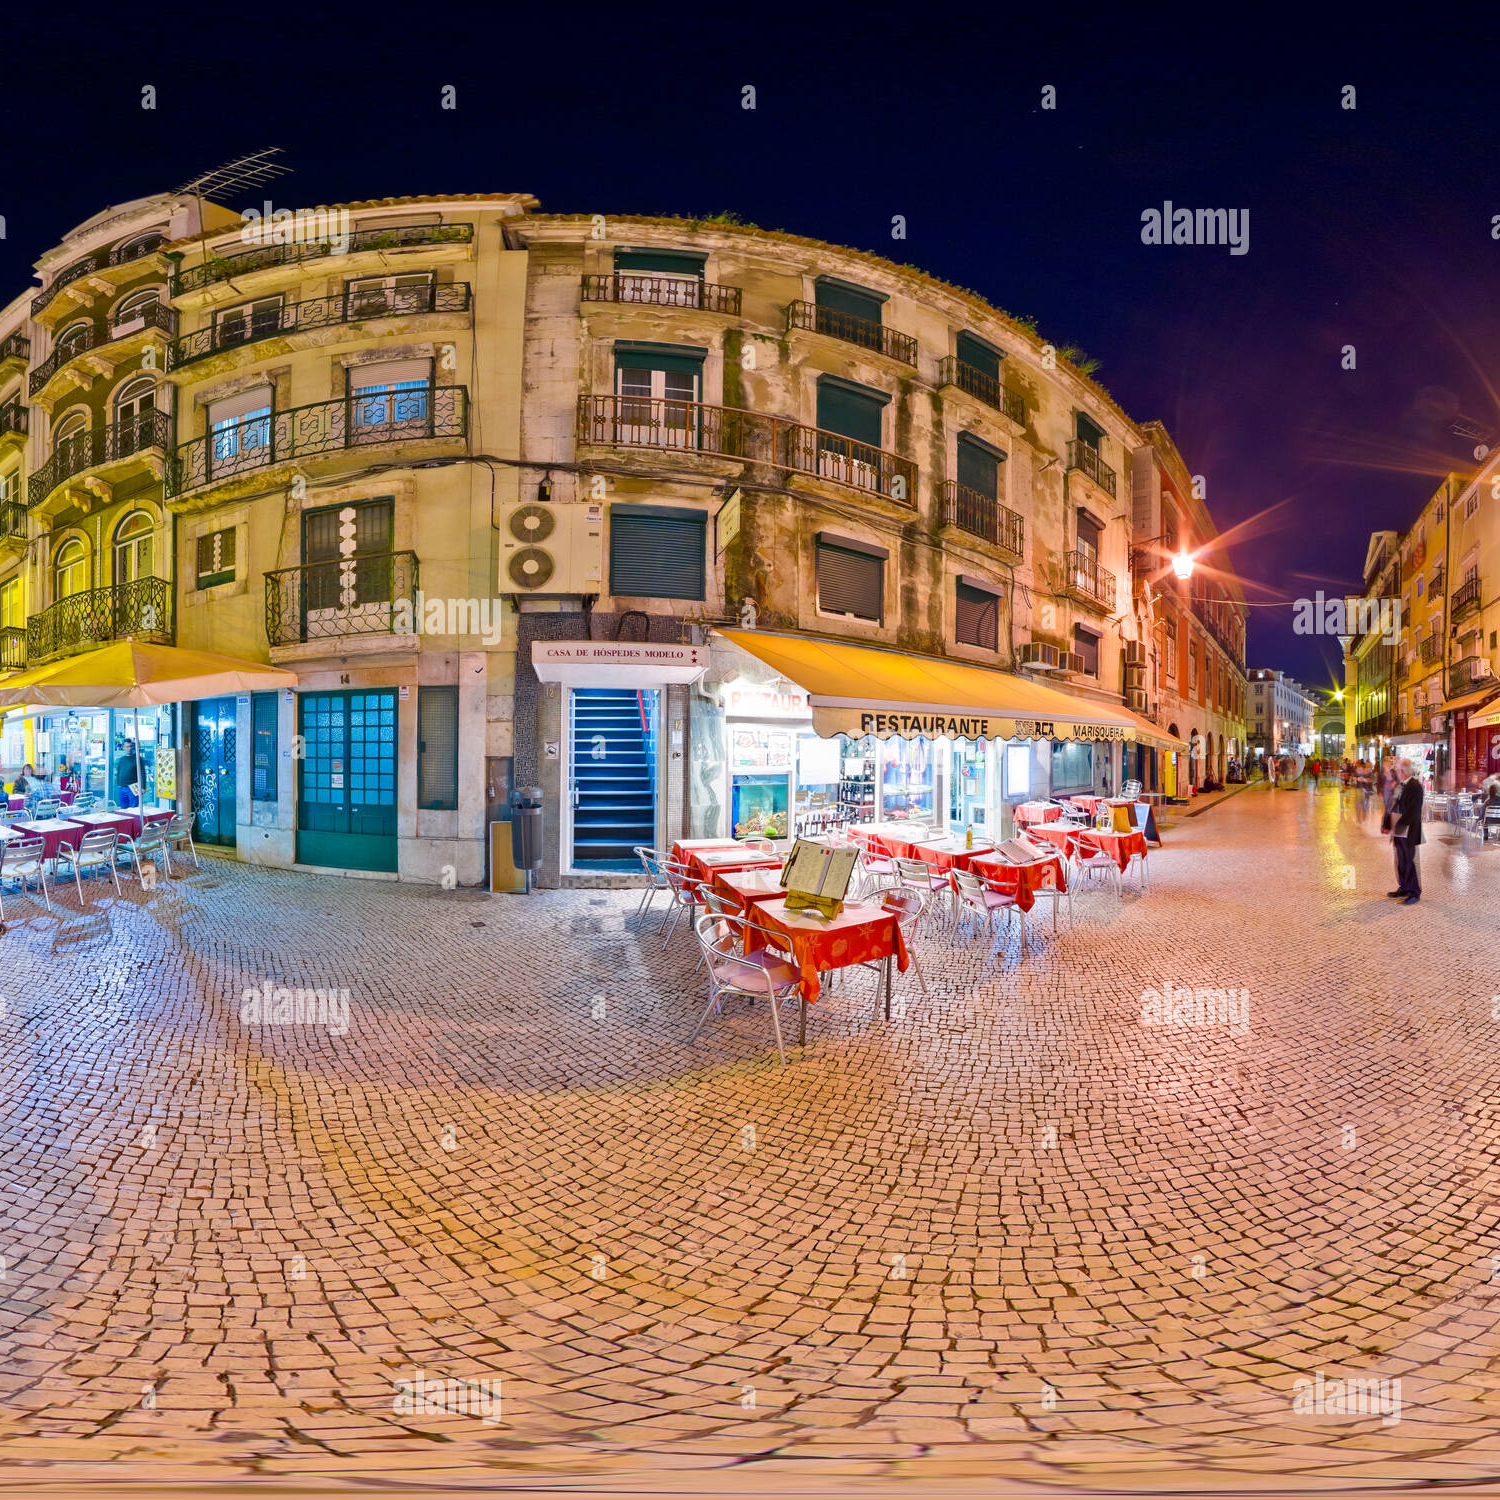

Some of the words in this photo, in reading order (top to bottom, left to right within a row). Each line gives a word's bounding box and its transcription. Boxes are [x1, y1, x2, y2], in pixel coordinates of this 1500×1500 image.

[547, 649, 571, 657] CASA
[576, 649, 589, 657] DE
[593, 647, 640, 658] HÓSPEDES
[644, 650, 684, 659] MODELO
[340, 674, 350, 684] 14
[861, 713, 988, 735] RESTAURANTE
[1073, 725, 1125, 739] MARISQUEIRA
